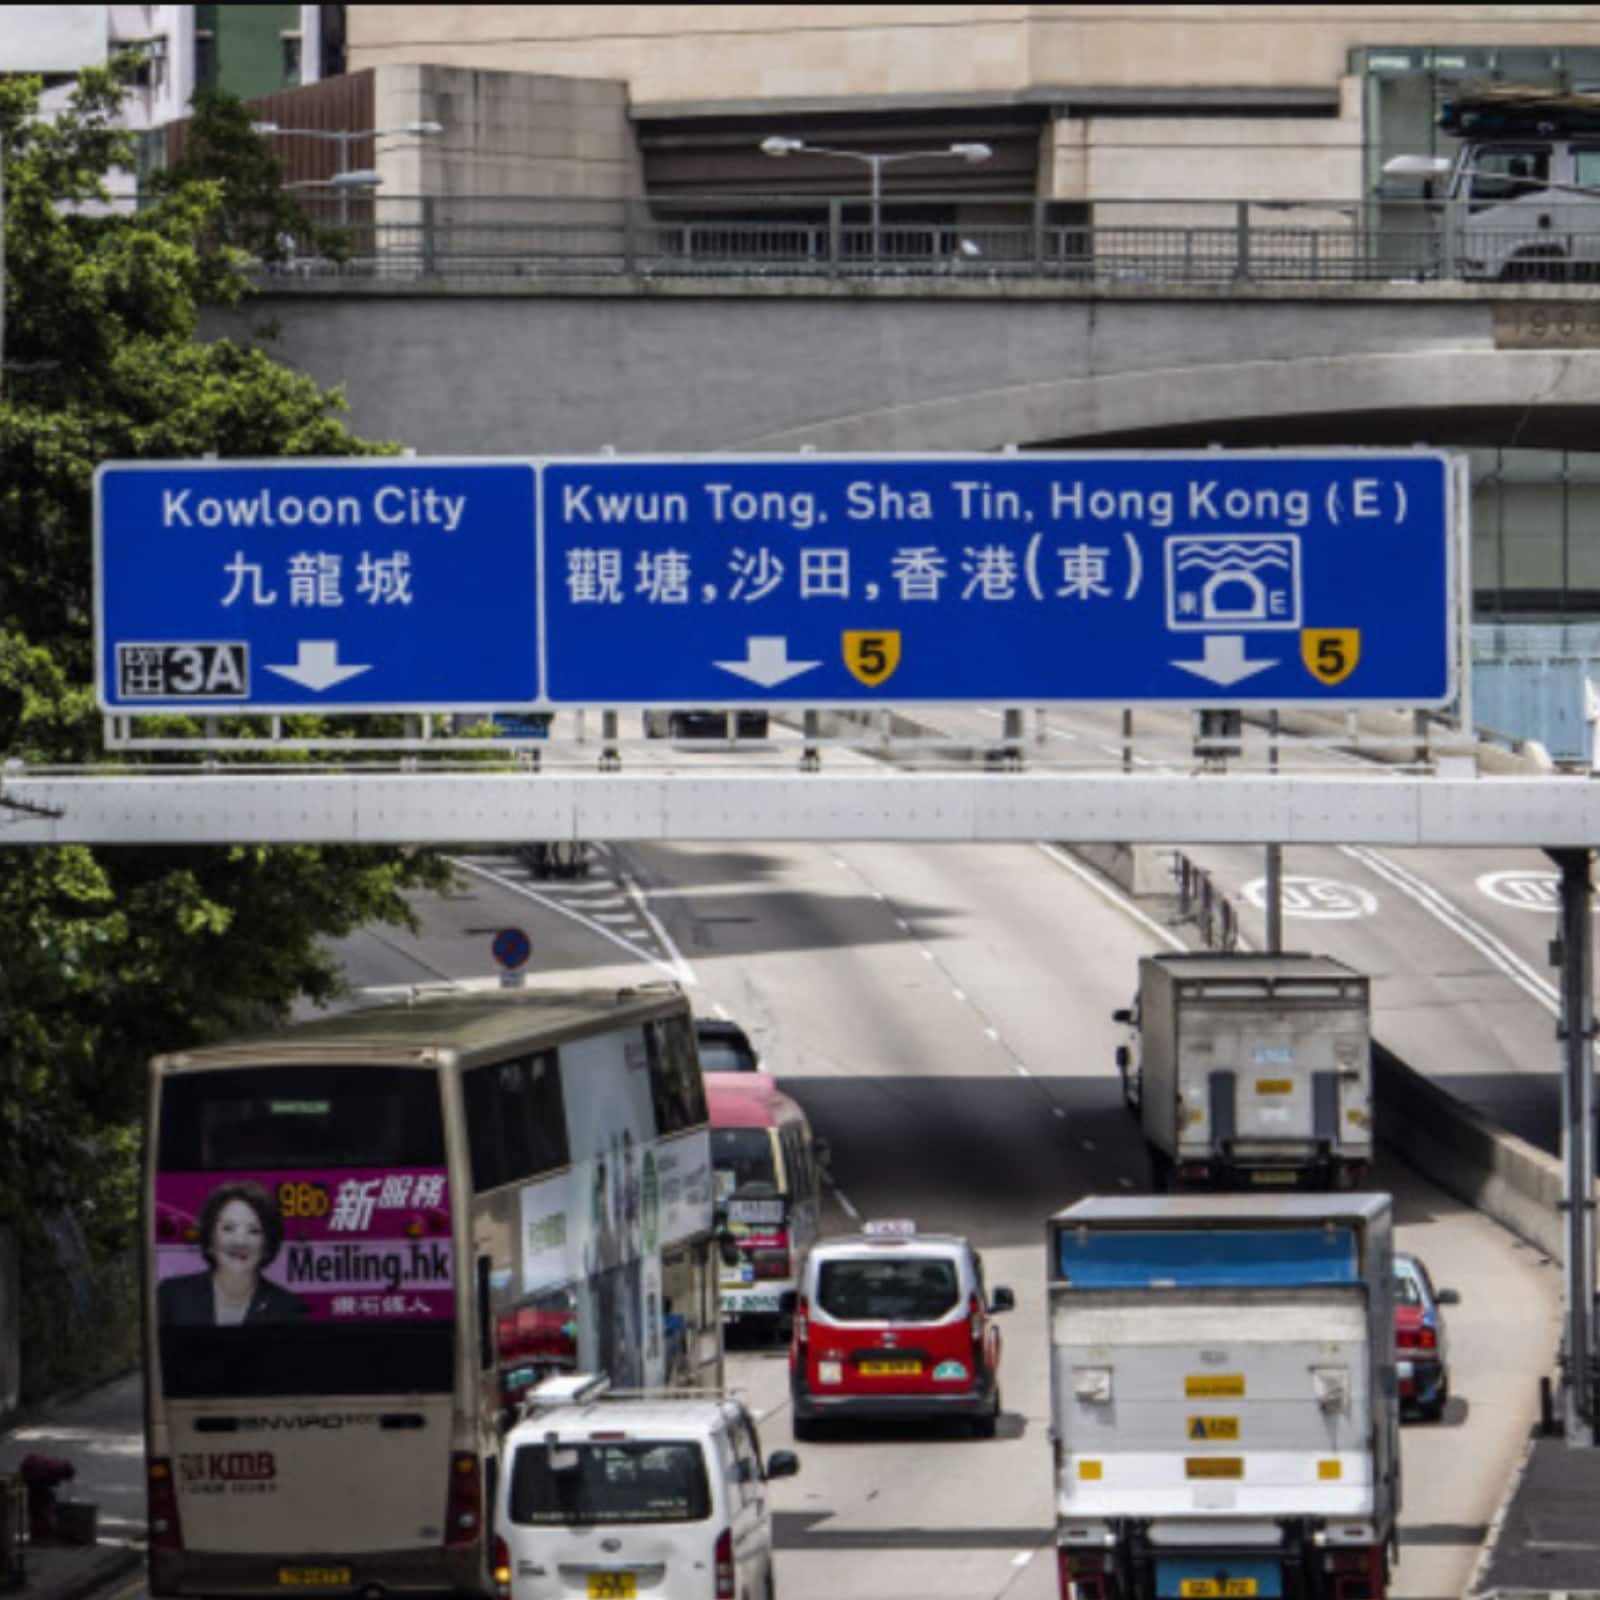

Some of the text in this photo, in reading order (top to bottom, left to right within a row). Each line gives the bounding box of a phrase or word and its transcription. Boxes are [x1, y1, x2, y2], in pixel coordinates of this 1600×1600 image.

[162, 487, 466, 531] Kowloon City
[563, 485, 687, 522] Kwun
[846, 482, 932, 520] Sha
[1051, 481, 1174, 527] Hong
[1188, 481, 1309, 527] Kong
[221, 551, 413, 606] 九龍城
[1269, 590, 1287, 615] E
[170, 646, 242, 693] 3A
[858, 638, 887, 676] 5
[1316, 638, 1345, 677] 5
[328, 1174, 447, 1232] 新服務
[286, 1243, 450, 1291] Meiling.hk
[208, 1451, 277, 1481] KMB
